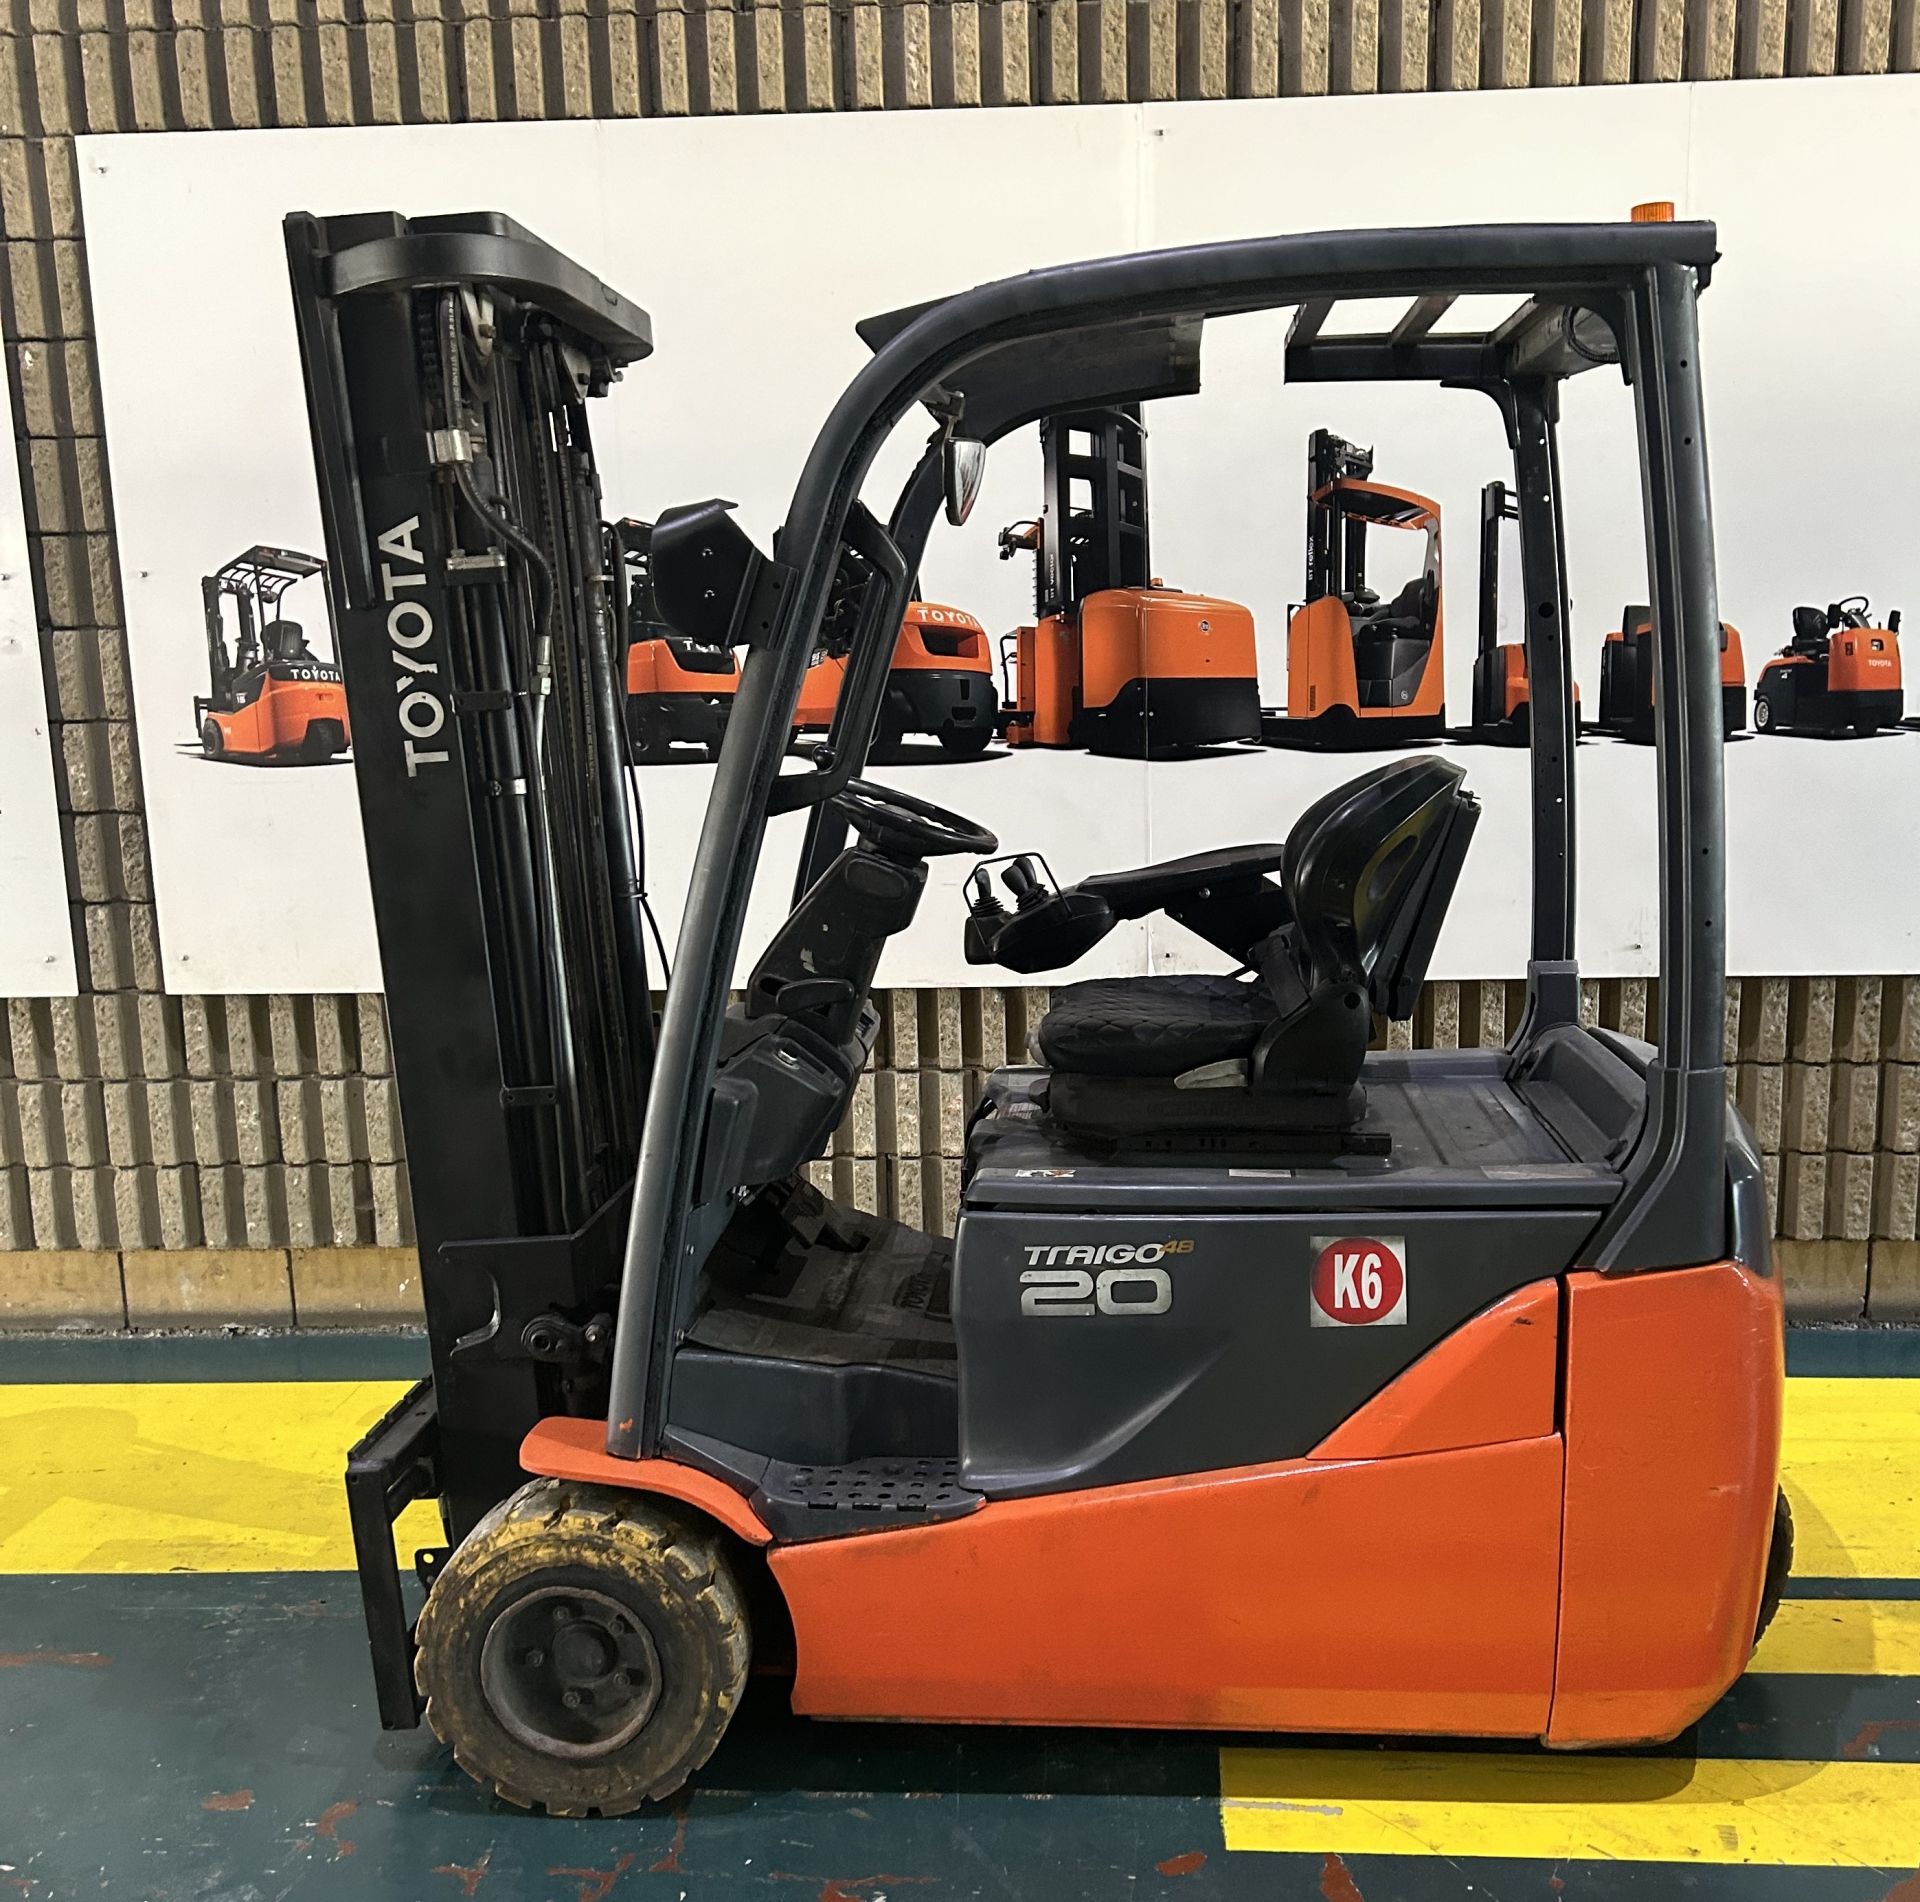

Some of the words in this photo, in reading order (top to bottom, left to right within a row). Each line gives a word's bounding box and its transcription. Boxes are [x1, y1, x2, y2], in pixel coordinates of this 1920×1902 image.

[916, 609, 980, 628] TOYOTA
[377, 515, 450, 778] TOYOTA
[290, 666, 341, 682] TOYOTA
[1868, 659, 1892, 667] TOYOTA
[1024, 1243, 1166, 1265] TRAIGO
[1019, 1268, 1173, 1316] 20
[1334, 1253, 1383, 1310] K6
